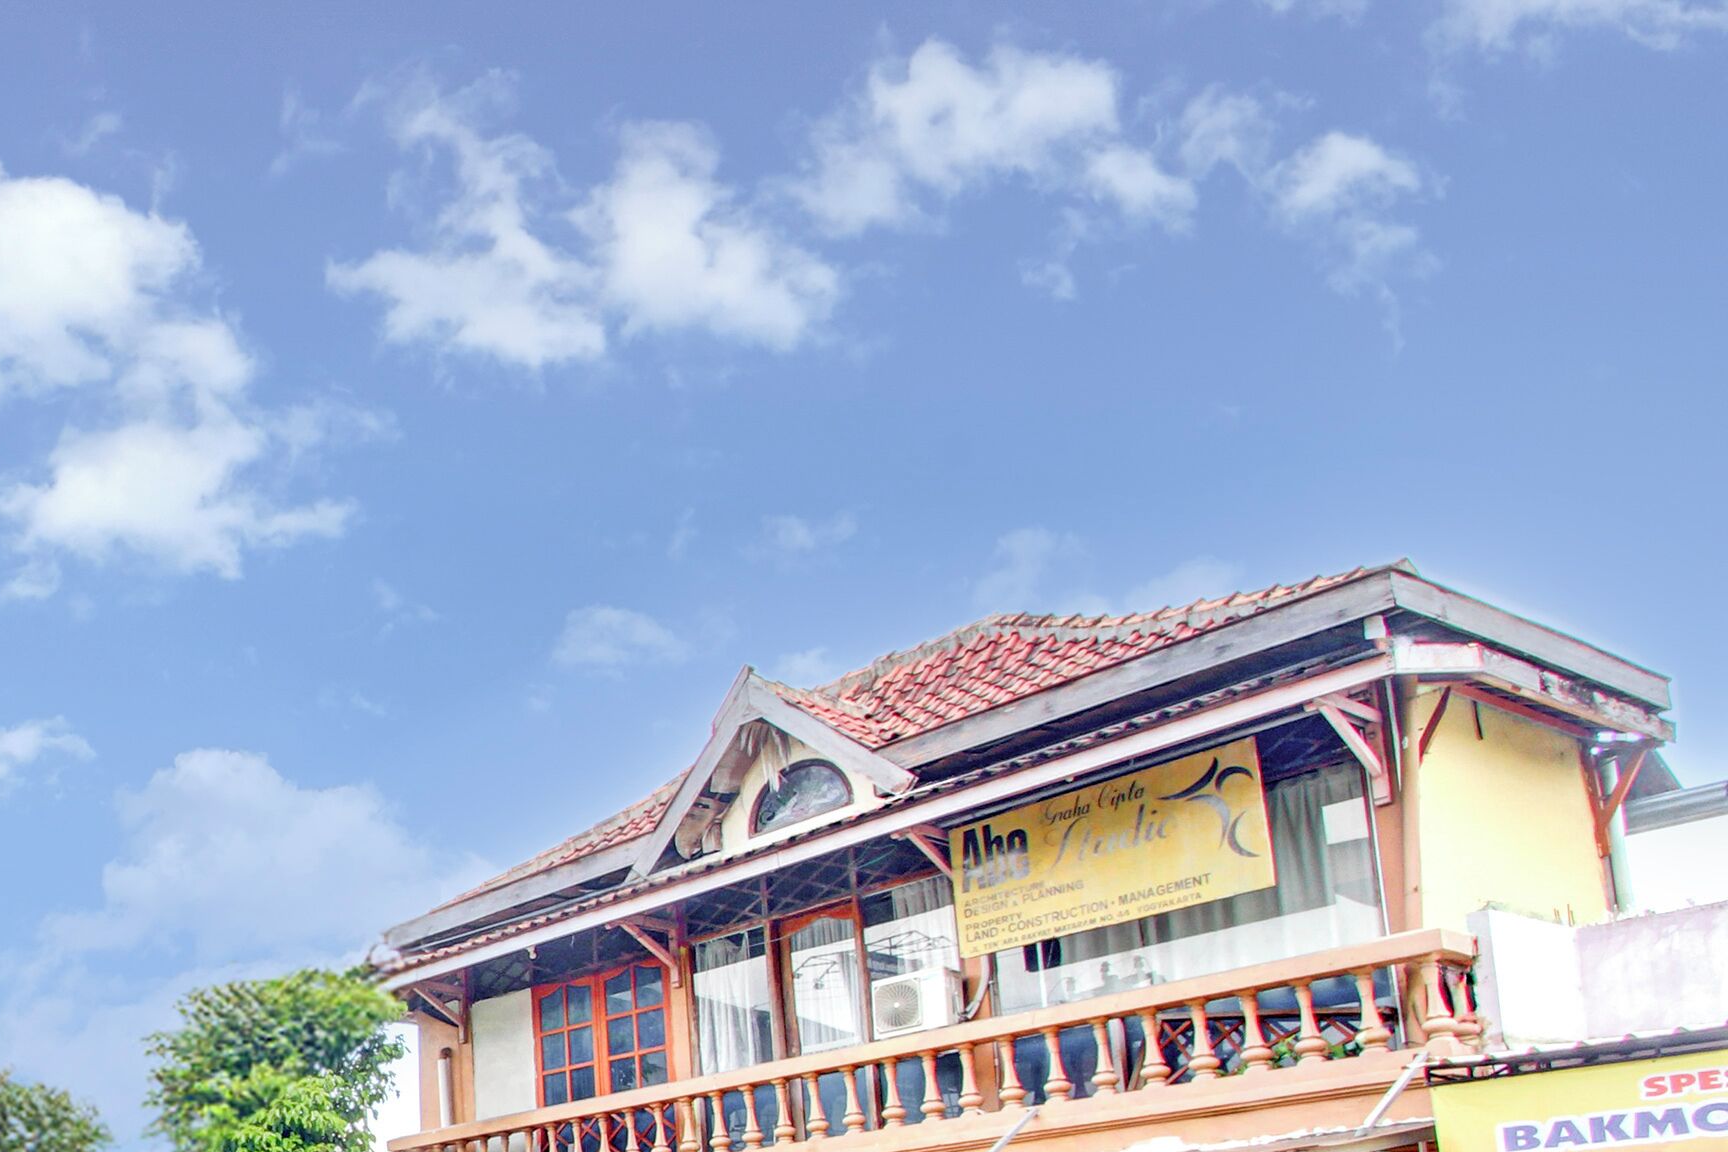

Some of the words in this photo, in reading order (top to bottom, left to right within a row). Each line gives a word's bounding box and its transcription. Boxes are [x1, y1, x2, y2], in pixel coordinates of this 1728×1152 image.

[963, 899, 1008, 919] DESIGN
[1021, 879, 1085, 904] PLANNING
[964, 880, 1045, 908] ARCHITECTURE
[966, 926, 1000, 943] LAND
[1007, 900, 1109, 933] CONSTRUCTION
[1118, 872, 1212, 906] MANAGEMENT
[965, 911, 1023, 931] PROPERTY
